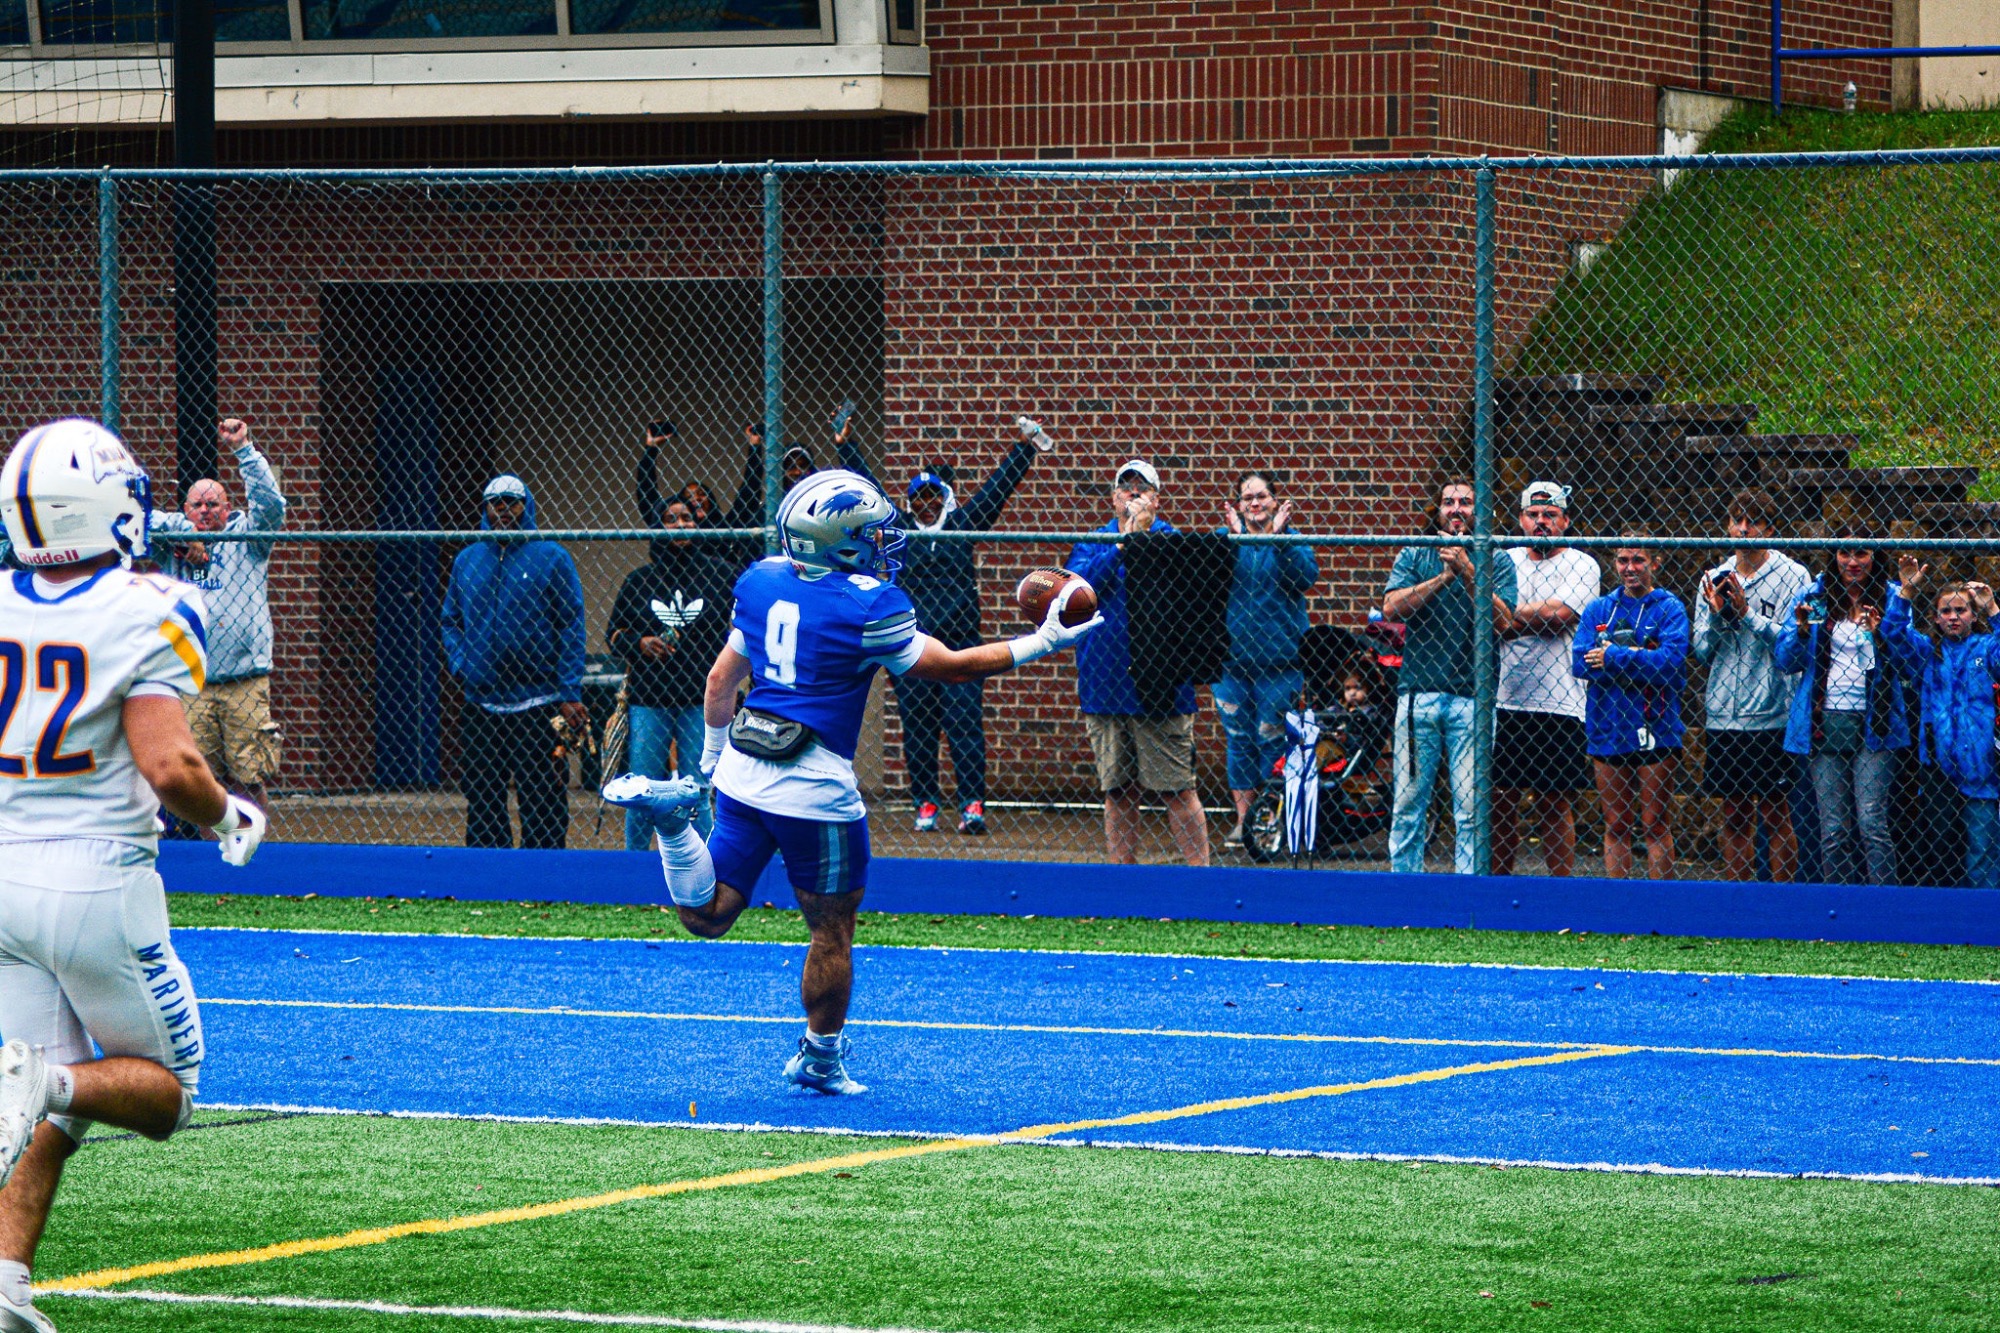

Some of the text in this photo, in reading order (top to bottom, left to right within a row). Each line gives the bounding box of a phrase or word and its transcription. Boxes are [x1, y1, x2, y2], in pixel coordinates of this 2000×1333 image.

[19, 549, 79, 565] Riddell
[847, 573, 881, 591] 9
[1029, 574, 1054, 588] Wilson
[764, 599, 800, 690] 9
[744, 716, 778, 734] Riddell
